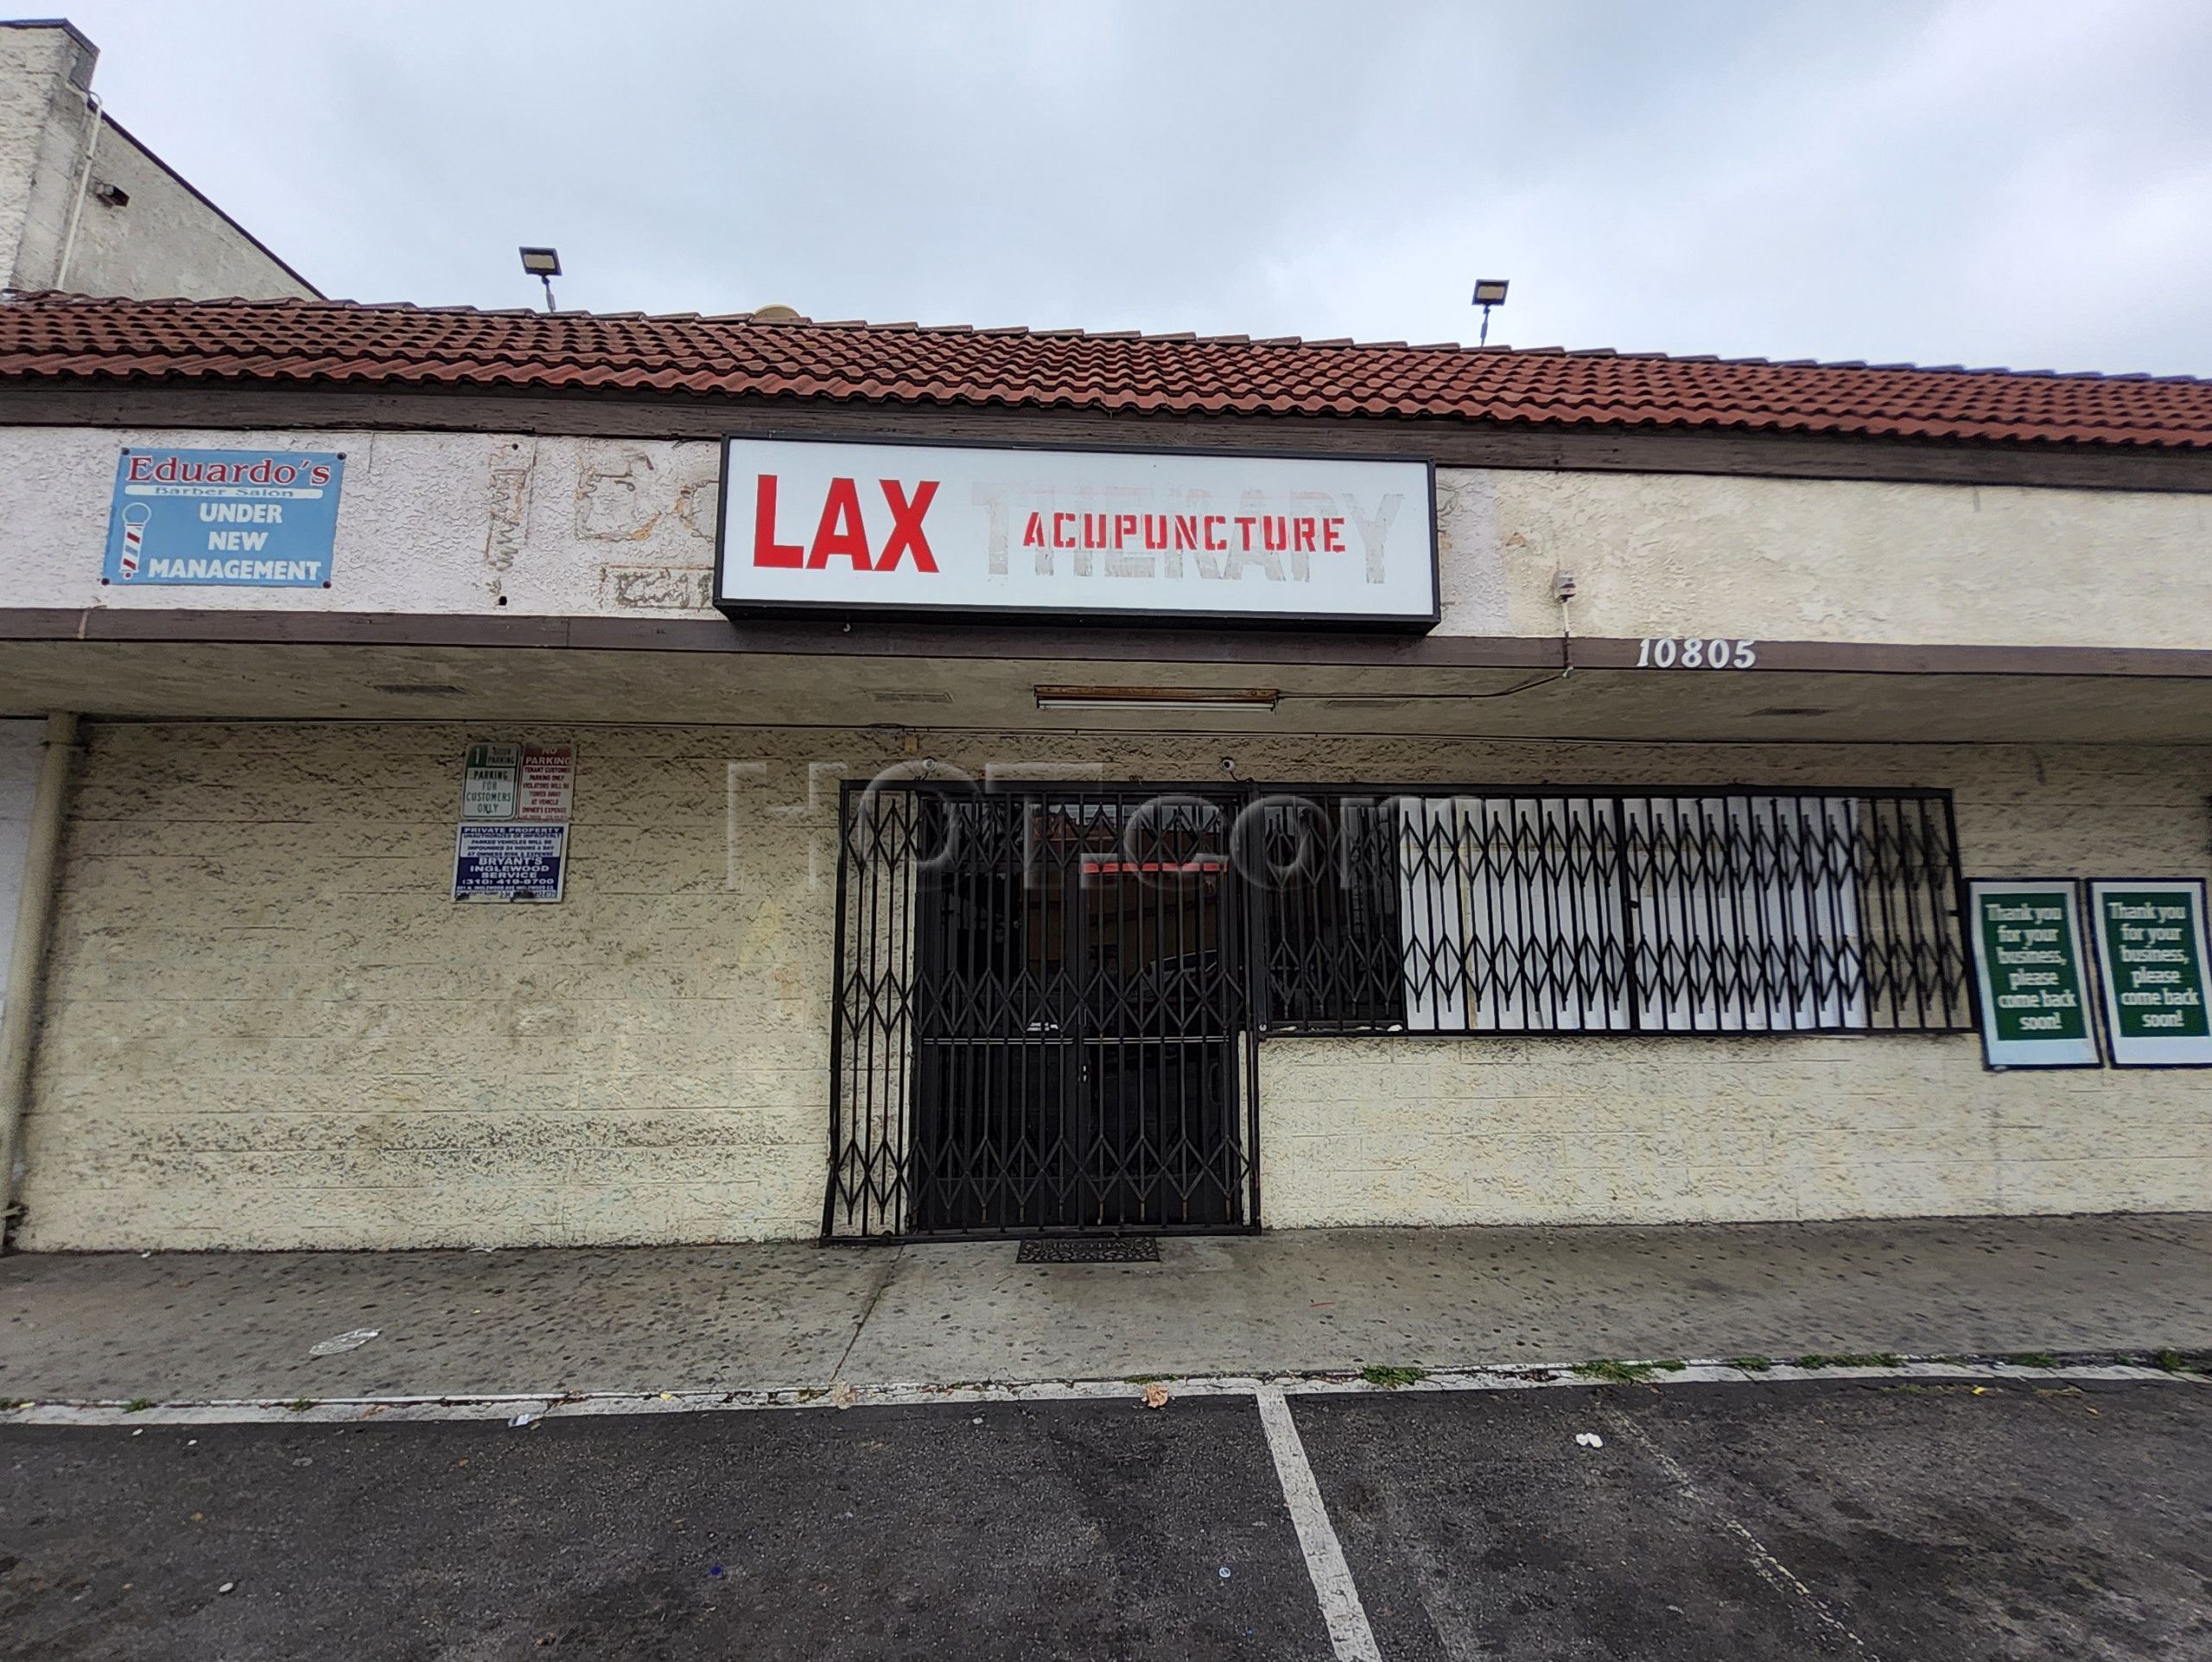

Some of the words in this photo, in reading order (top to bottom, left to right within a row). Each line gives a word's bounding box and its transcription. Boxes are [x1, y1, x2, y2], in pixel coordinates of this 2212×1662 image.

[126, 455, 331, 486] Eduardo's
[155, 487, 226, 497] Barber
[235, 487, 294, 498] Salon
[199, 502, 283, 524] UNDER
[753, 474, 940, 574] LAX
[1023, 511, 1345, 553] ACUPUNCTURE
[207, 532, 269, 551] NEW
[147, 558, 321, 581] MANAGEMENT
[1636, 637, 1756, 669] 10805
[542, 746, 558, 755] NO
[474, 770, 508, 780] PARKING
[482, 781, 498, 790] FOR
[467, 793, 512, 802] CUSTOMERS
[478, 804, 499, 813] ONLY
[479, 856, 543, 865] BRYANT'S
[1985, 903, 2035, 920] Thank
[2030, 907, 2063, 925] you
[2107, 902, 2158, 920] Thank
[2153, 907, 2186, 924] you
[1997, 925, 2021, 942] for
[2022, 929, 2059, 950] your
[2120, 923, 2145, 940] for
[2145, 927, 2182, 948] your
[1996, 946, 2067, 965] business,
[2119, 945, 2190, 965] business,
[2009, 968, 2060, 990] please
[2131, 966, 2181, 988] please
[1998, 995, 2040, 1008] come
[2039, 989, 2077, 1007] back
[2120, 991, 2162, 1005] come
[2162, 988, 2200, 1005] back
[2019, 1012, 2063, 1030] soon!
[2141, 1009, 2185, 1028] soon!
